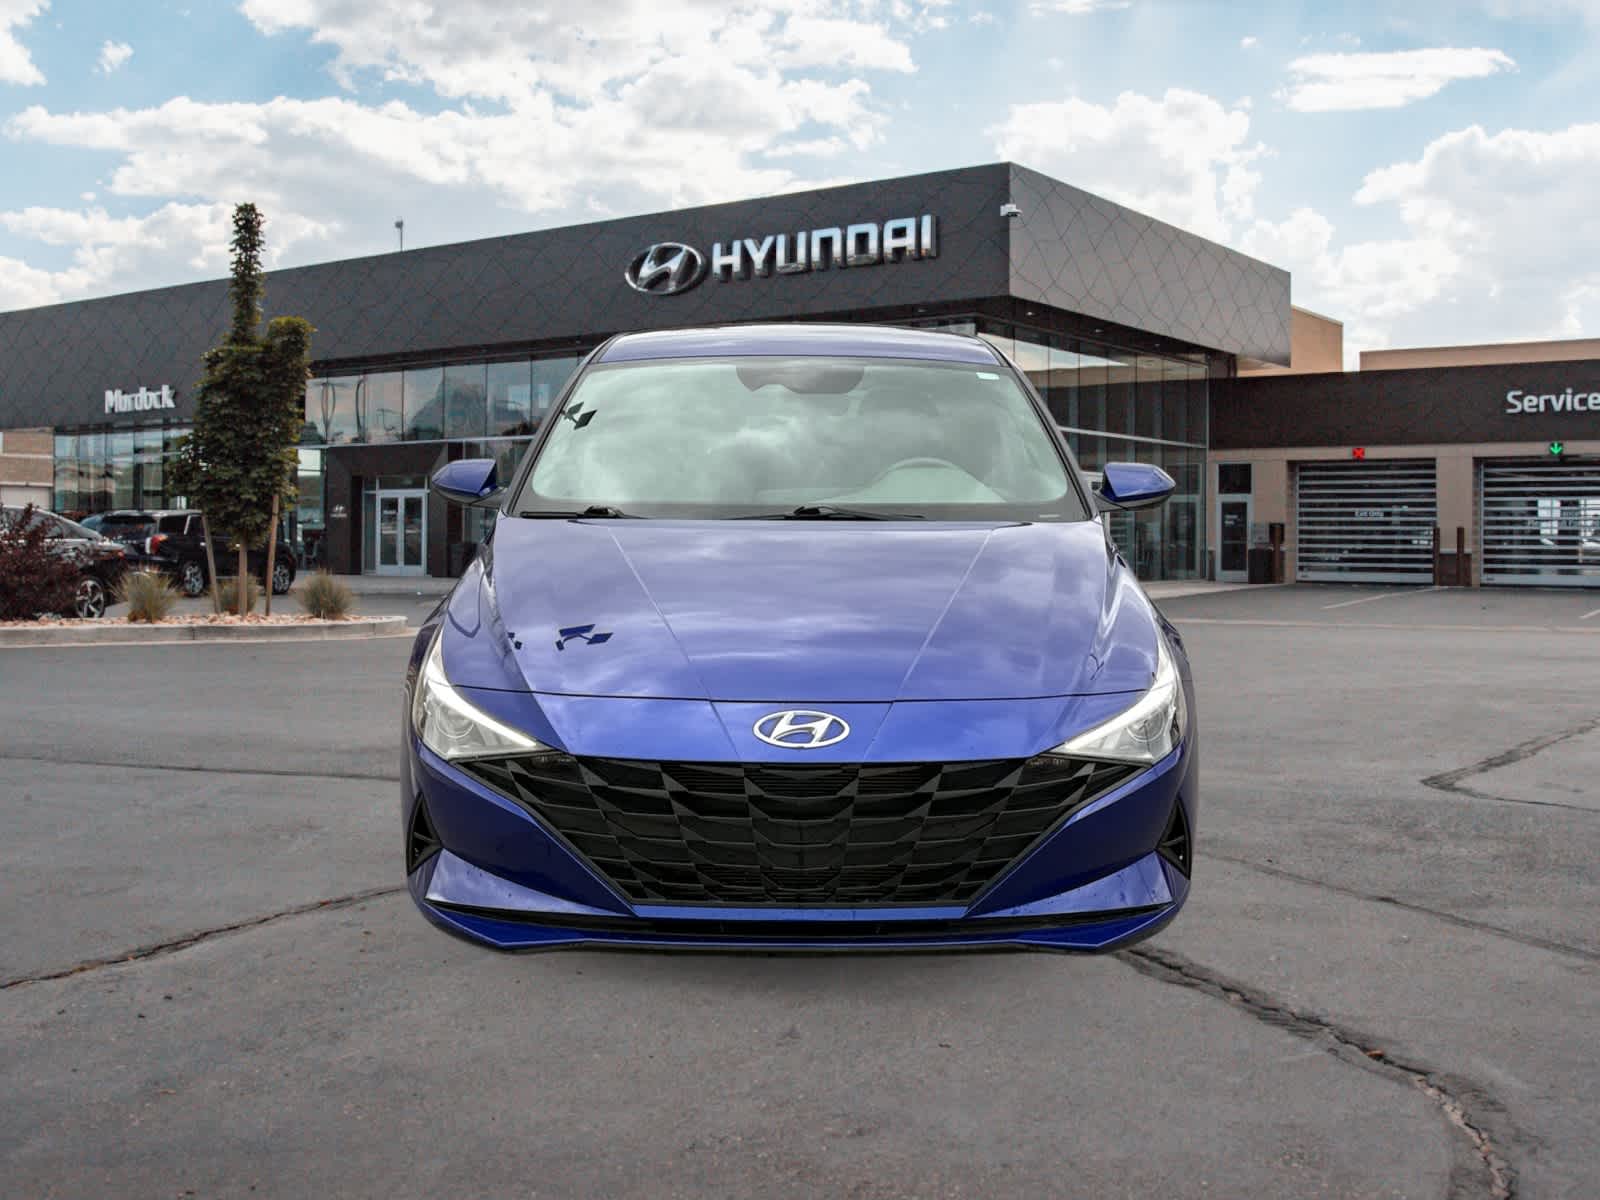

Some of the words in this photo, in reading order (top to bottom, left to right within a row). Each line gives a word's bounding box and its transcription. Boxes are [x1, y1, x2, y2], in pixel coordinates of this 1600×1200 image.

[711, 213, 936, 282] HYUNDAI
[104, 384, 176, 414] Murdock
[1505, 387, 1600, 414] Service
